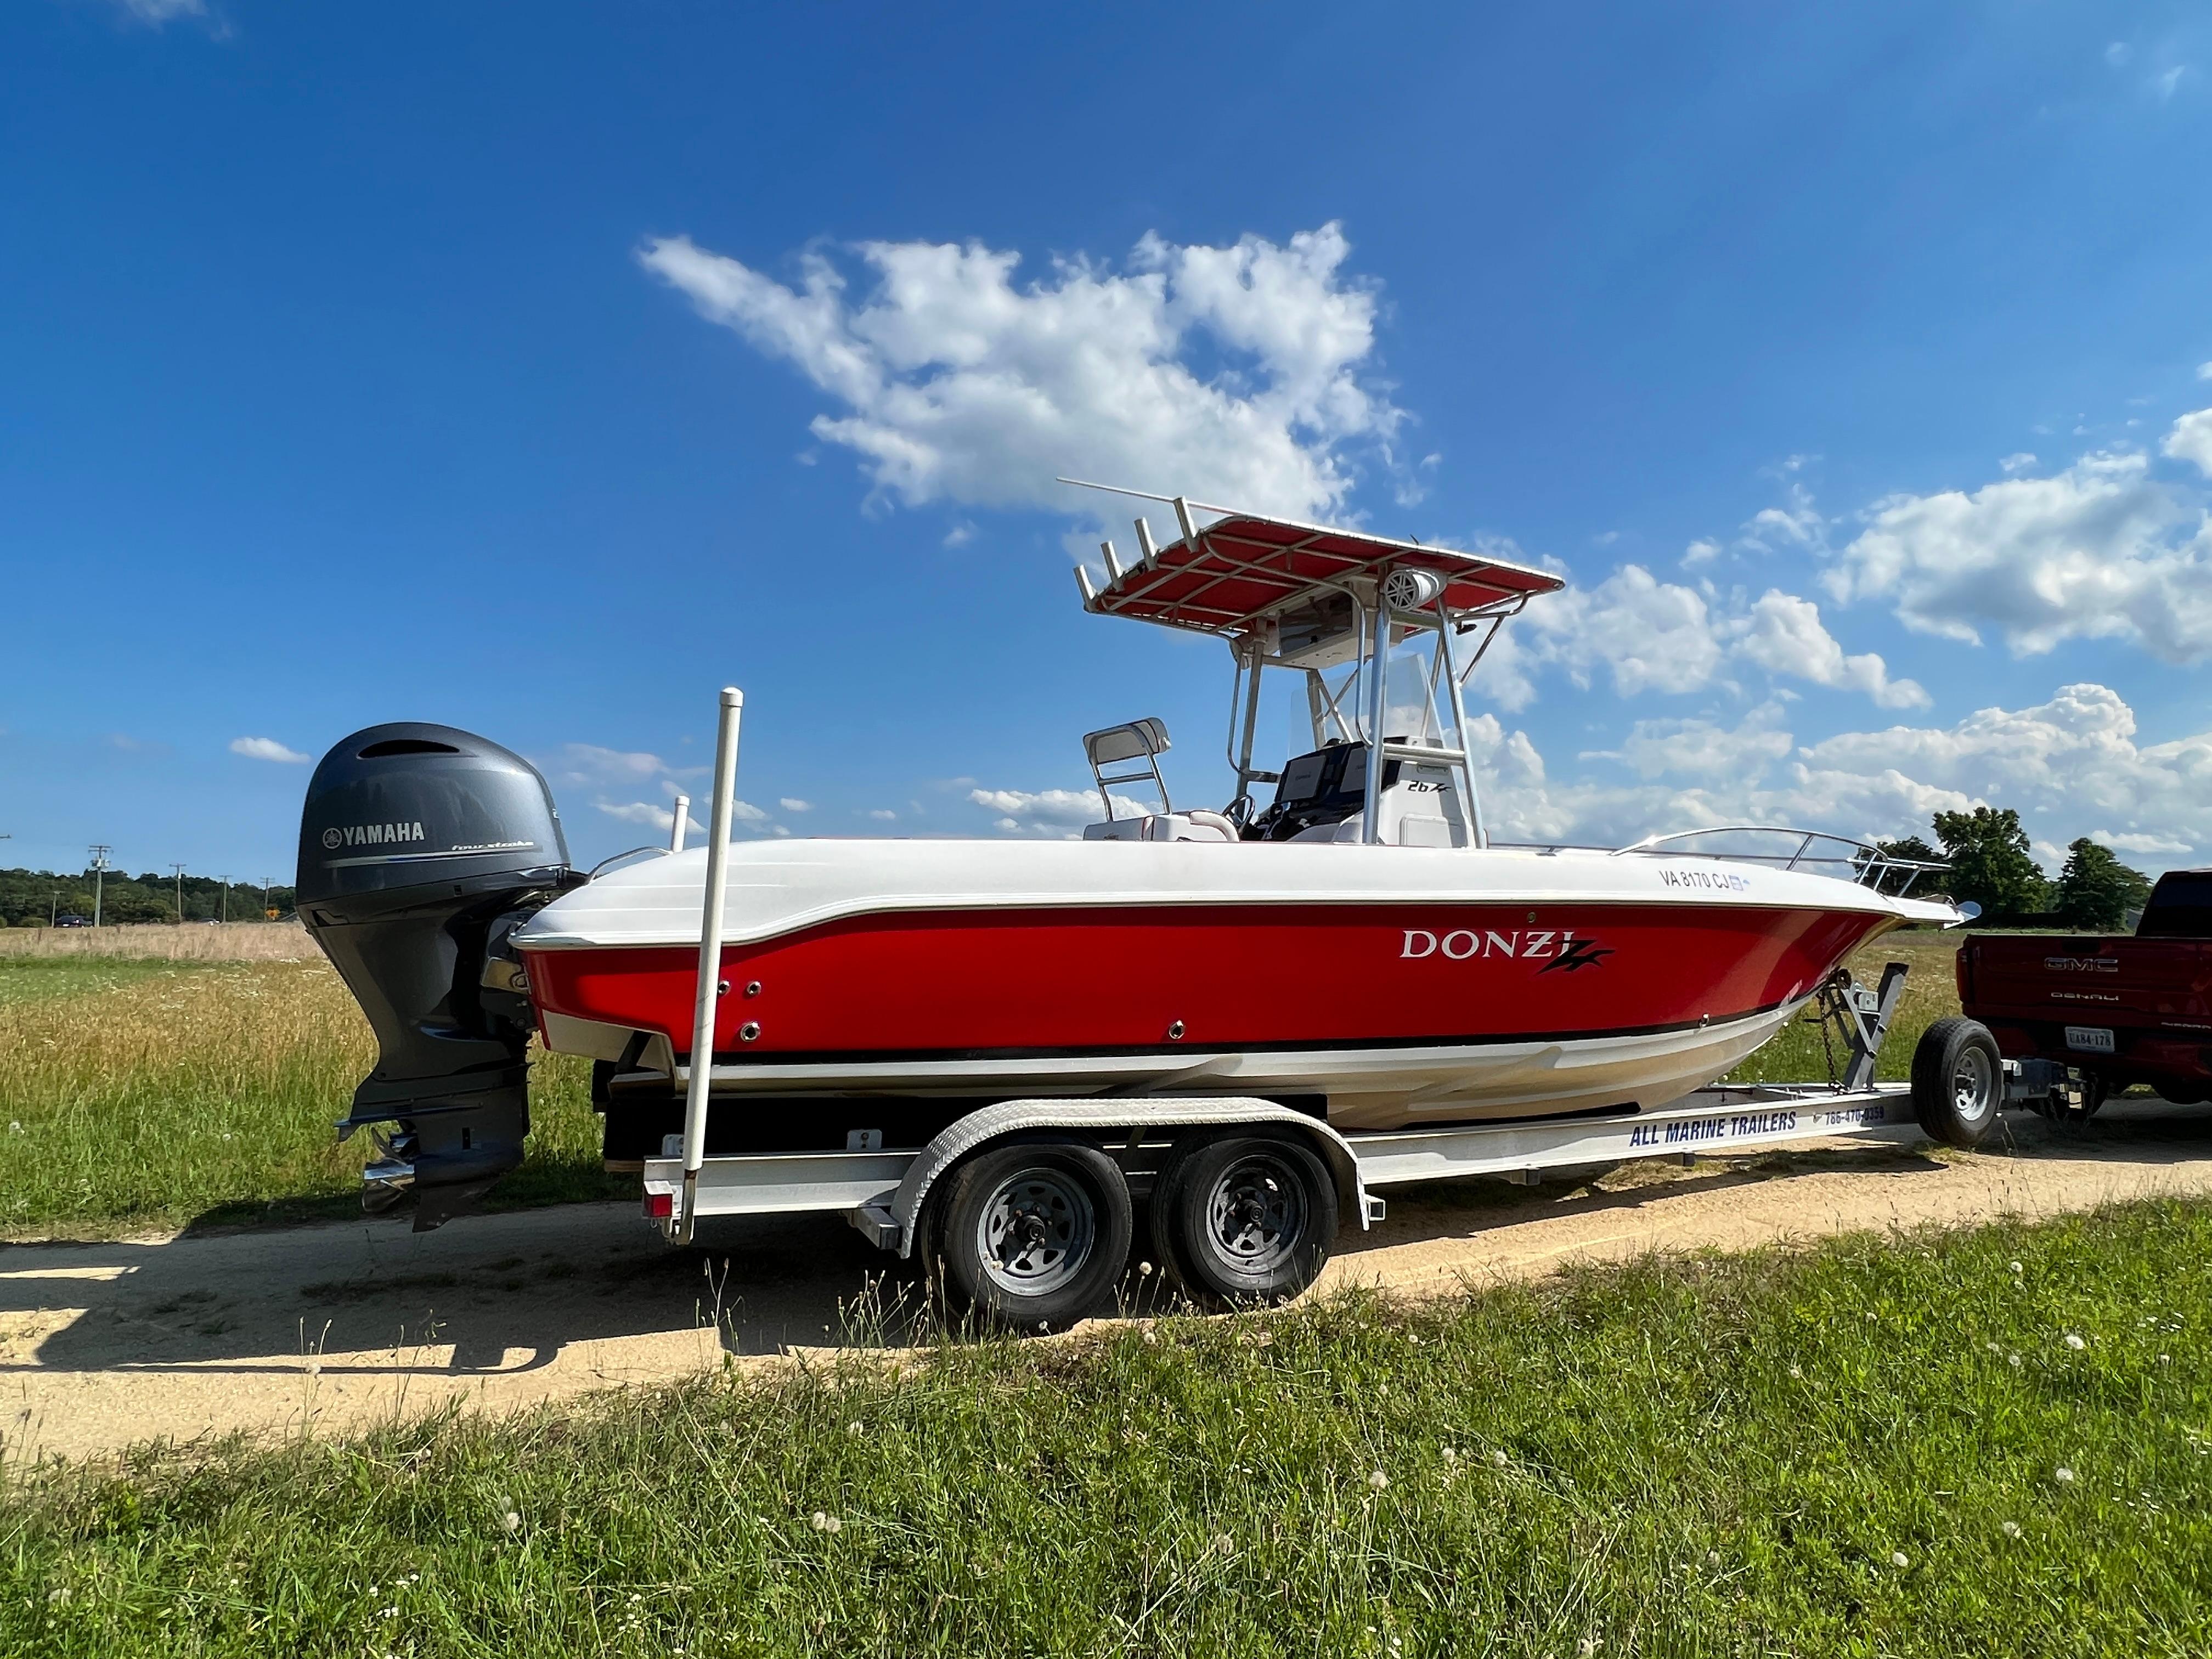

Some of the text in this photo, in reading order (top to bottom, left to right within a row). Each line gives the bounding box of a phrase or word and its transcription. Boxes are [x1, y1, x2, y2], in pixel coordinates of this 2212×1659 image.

[344, 822, 425, 846] YAMAHA
[1659, 871, 1729, 888] VA 8170 CJ
[1400, 929, 1575, 959] DONZI
[2045, 957, 2118, 972] GMC
[2051, 992, 2119, 1001] DENALI
[1629, 1126, 1659, 1147] ALL
[1665, 1119, 1725, 1143] MARINE
[1730, 1111, 1796, 1135] TRAILERS
